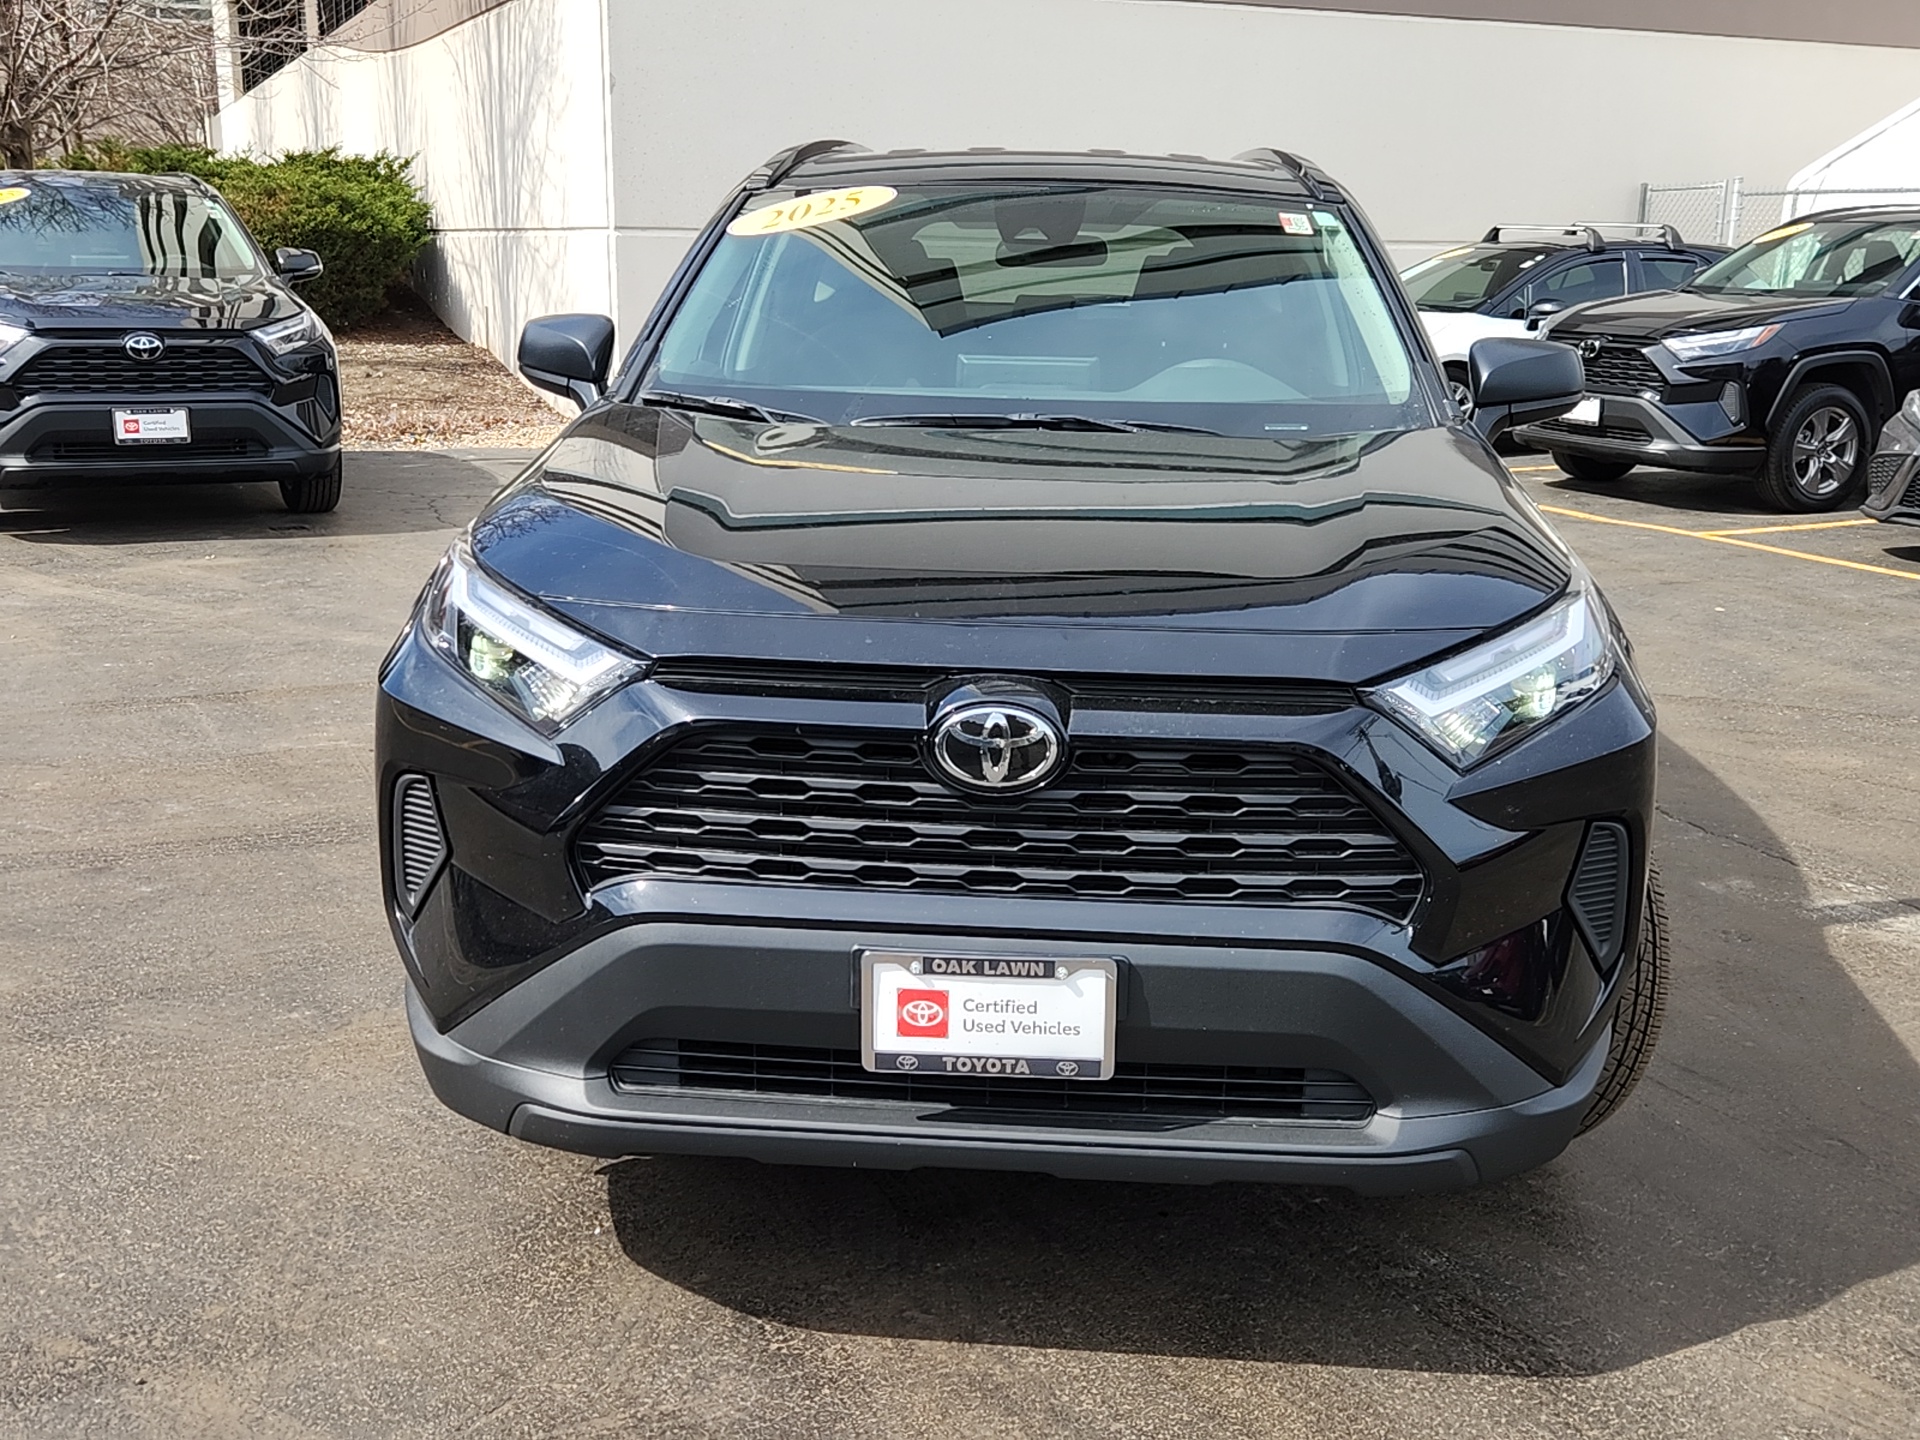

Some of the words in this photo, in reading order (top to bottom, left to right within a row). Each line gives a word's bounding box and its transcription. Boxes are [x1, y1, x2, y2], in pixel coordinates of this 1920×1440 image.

[761, 190, 863, 229] 2025
[931, 959, 978, 974] OAK
[983, 961, 1044, 976] LAWN
[963, 999, 1037, 1014] Certified
[963, 1019, 1006, 1034] Used
[1010, 1020, 1081, 1036] Vehicles
[942, 1057, 1030, 1074] TOYOTA
